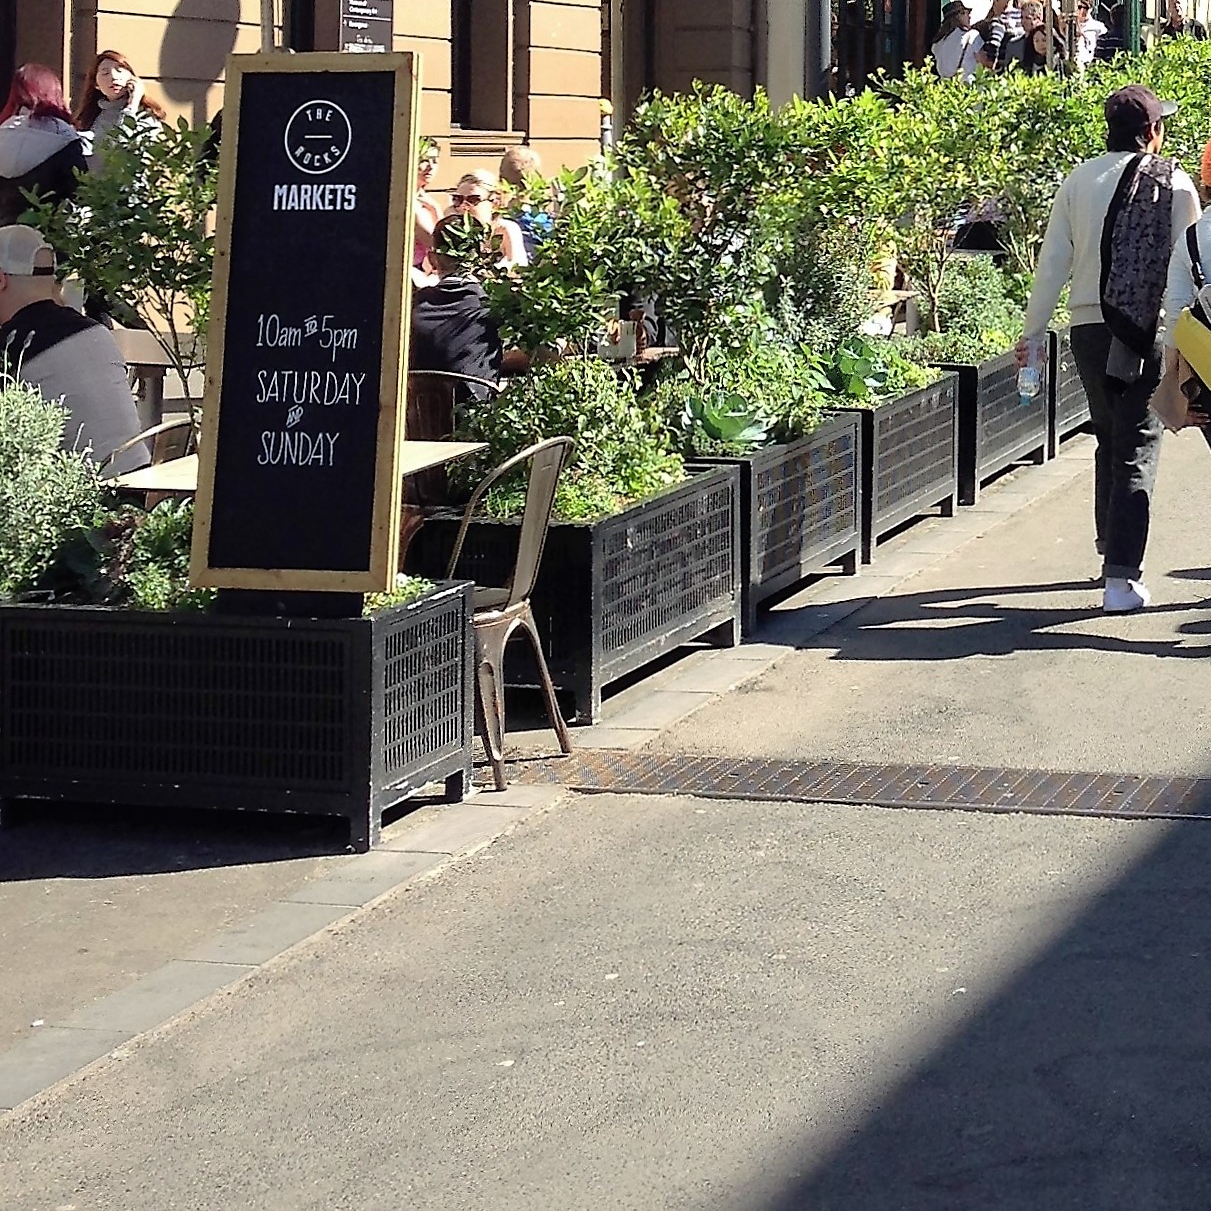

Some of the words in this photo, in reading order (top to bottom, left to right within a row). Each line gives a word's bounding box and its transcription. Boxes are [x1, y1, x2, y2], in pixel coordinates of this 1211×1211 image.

[305, 108, 333, 122] THE
[294, 145, 341, 167] ROCKS
[273, 184, 356, 211] MARKETS
[256, 313, 302, 349] 10am
[319, 315, 358, 363] 5pm
[256, 370, 366, 407] SATURDAY
[286, 405, 304, 429] AND
[256, 431, 340, 467] SUNDAY
